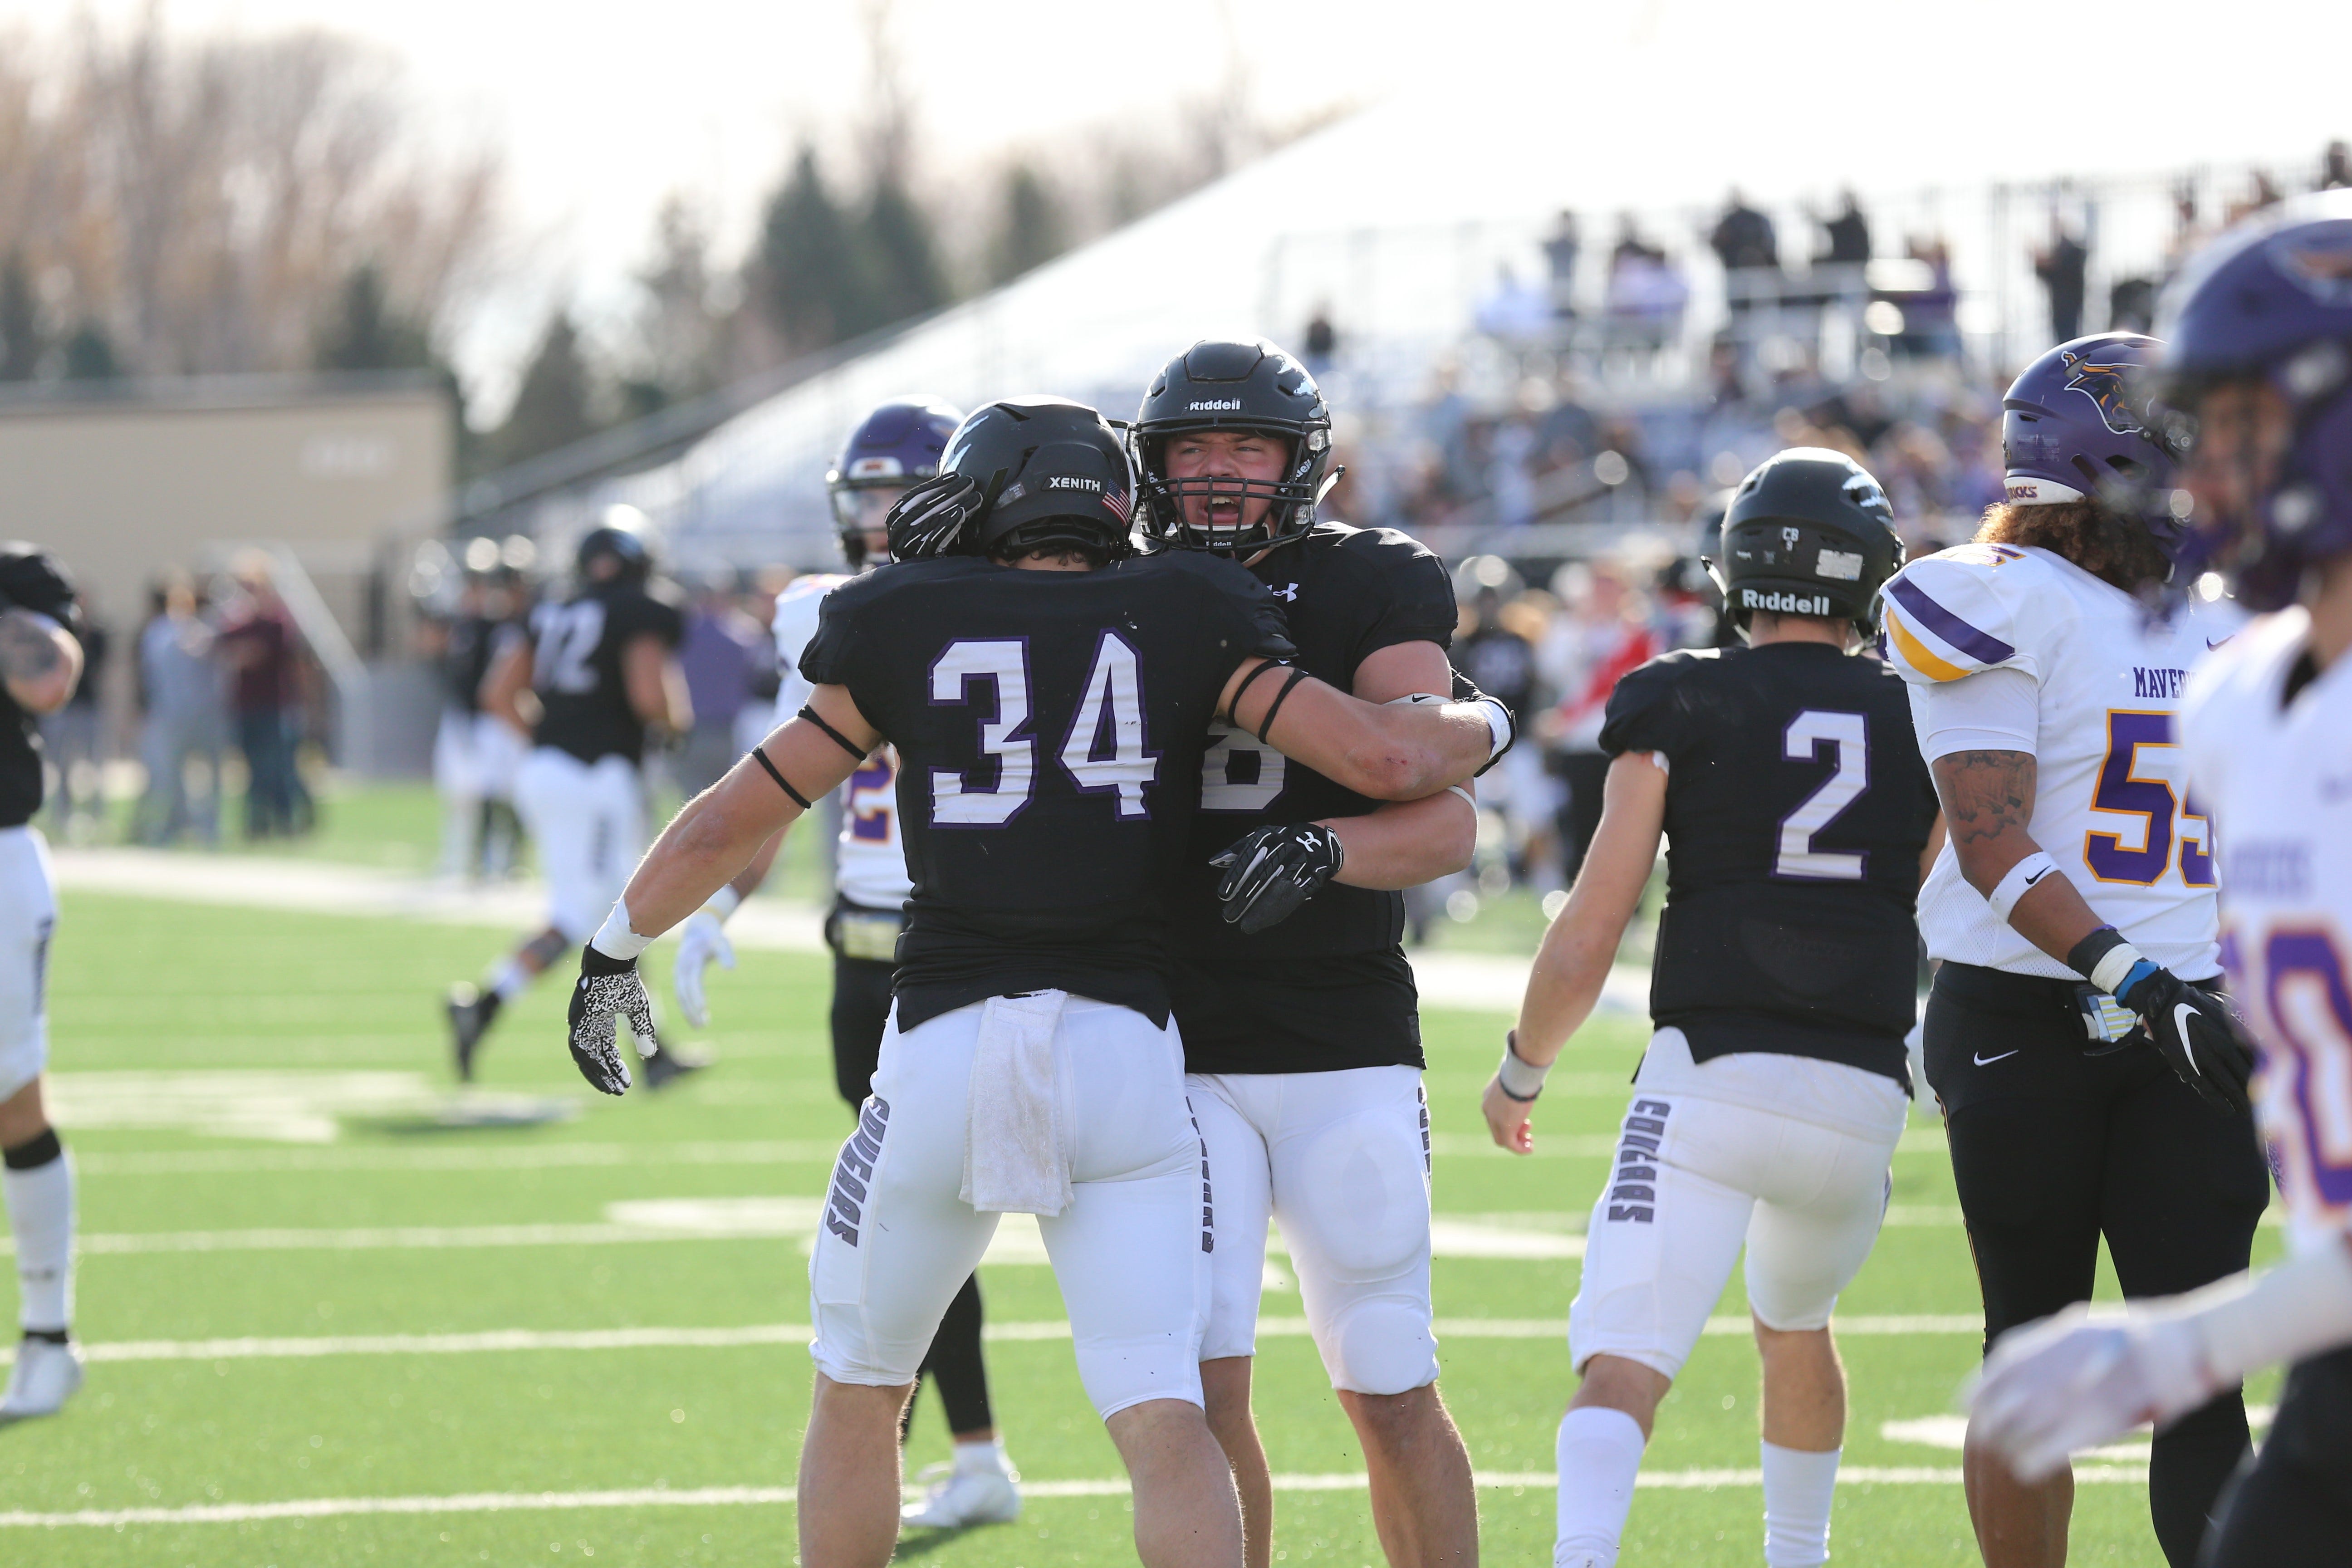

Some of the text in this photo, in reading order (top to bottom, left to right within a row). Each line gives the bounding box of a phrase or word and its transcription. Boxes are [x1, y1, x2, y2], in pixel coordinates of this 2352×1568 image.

[1190, 398, 1241, 411] Riddell
[1049, 477, 1101, 492] XENITH
[1782, 527, 1799, 542] CB
[1742, 589, 1830, 616] Riddell
[927, 627, 1163, 829] 34
[1771, 707, 1872, 880] 2
[826, 1097, 891, 1248] COUGARS
[1608, 1100, 1672, 1223] COUGARS
